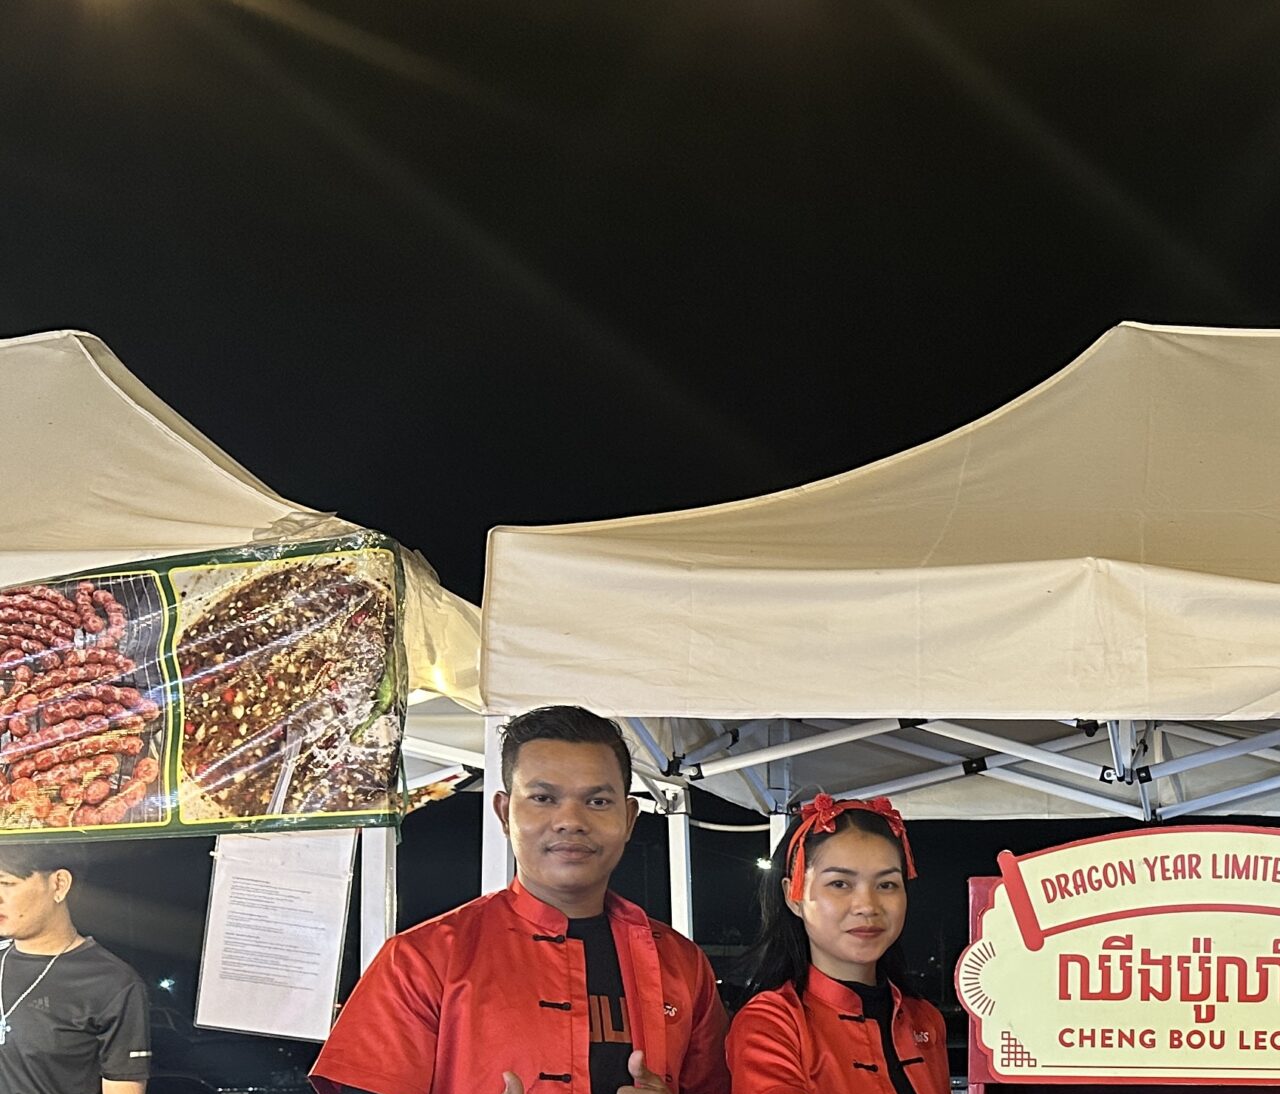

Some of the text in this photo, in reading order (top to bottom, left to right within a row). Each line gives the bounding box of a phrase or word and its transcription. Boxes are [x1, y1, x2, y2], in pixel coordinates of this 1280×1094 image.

[1041, 857, 1137, 904] DRAGON
[1143, 853, 1202, 883] YEAR
[1058, 1028, 1156, 1048] CHENG
[1169, 1029, 1226, 1050] BOU
